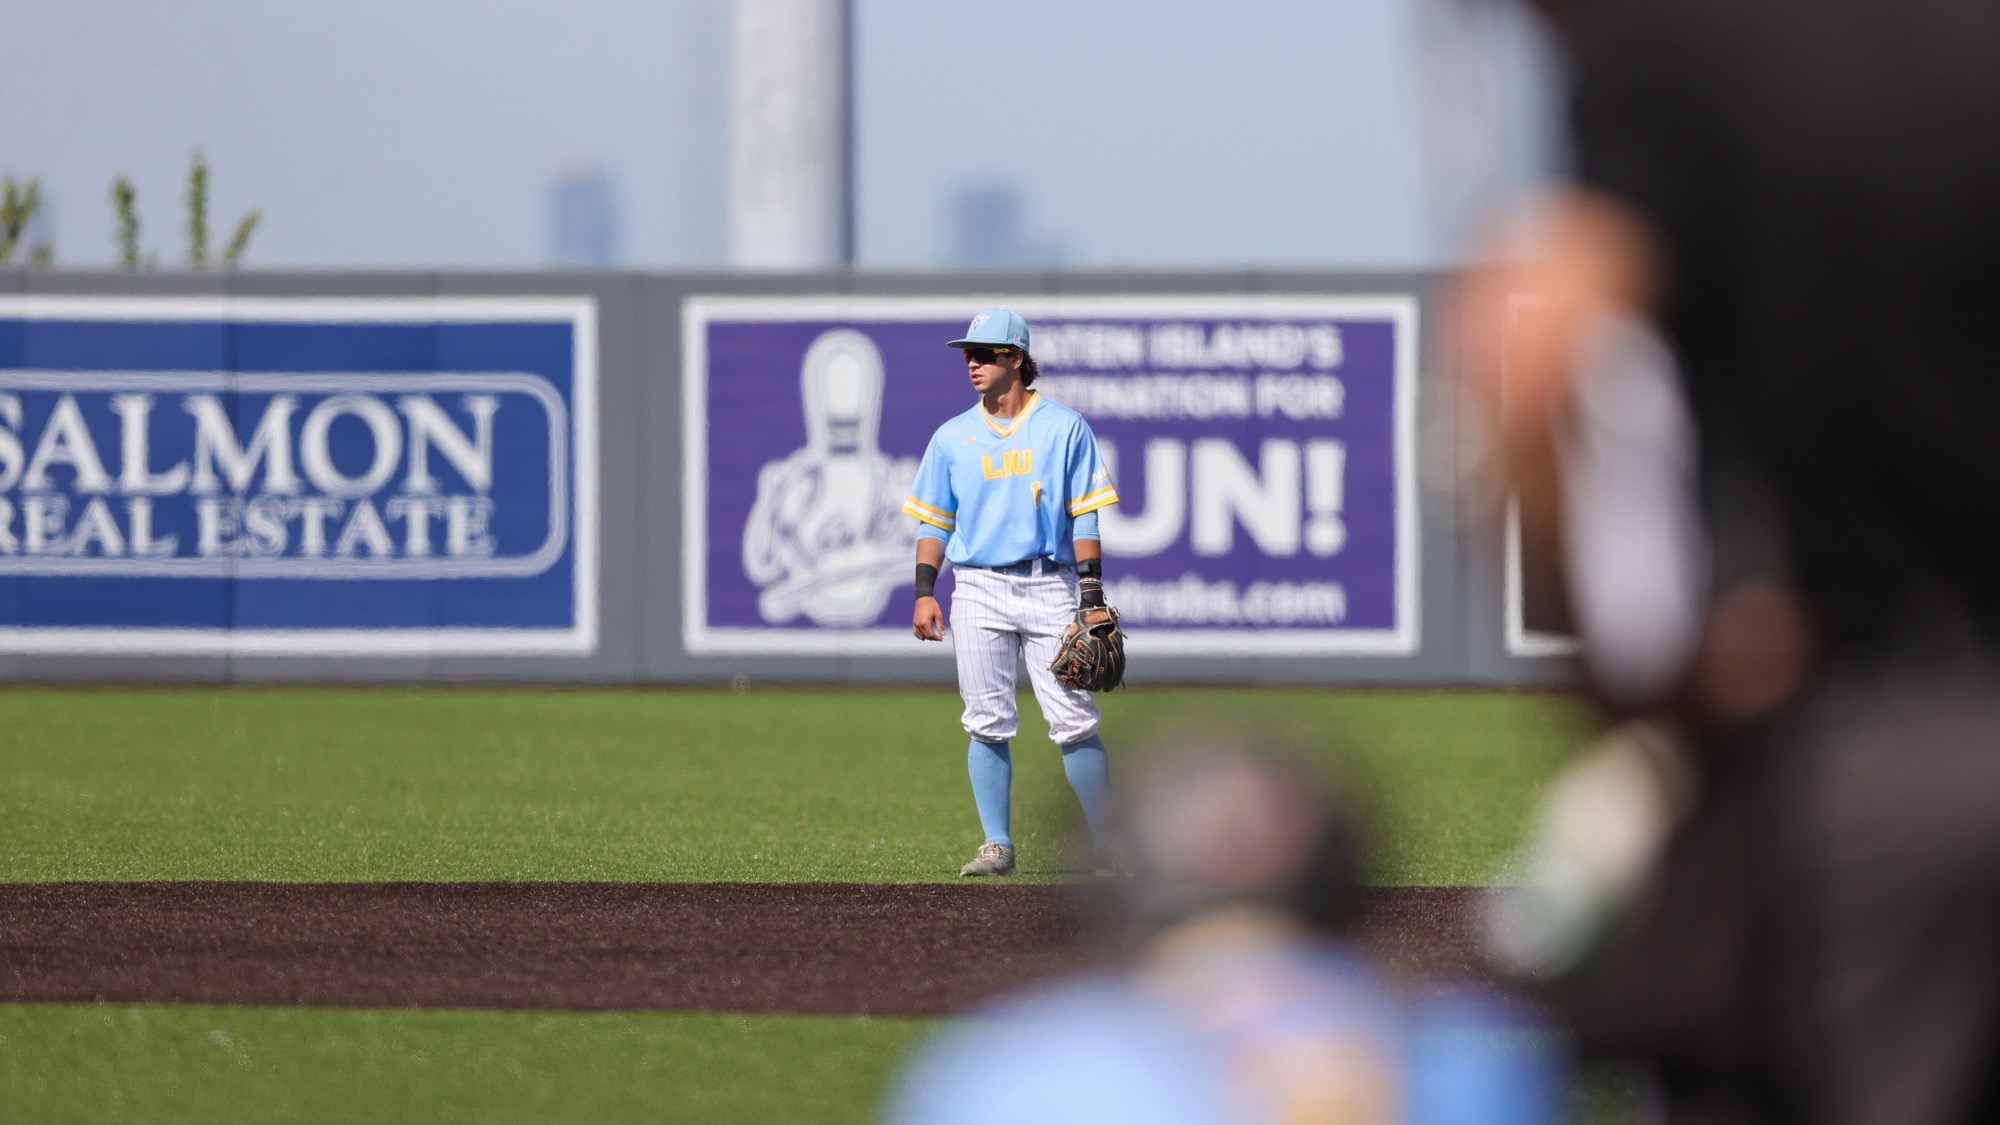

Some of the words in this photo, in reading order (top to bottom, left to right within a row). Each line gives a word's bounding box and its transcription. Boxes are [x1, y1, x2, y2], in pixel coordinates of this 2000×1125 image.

[1029, 325, 1141, 365] ATEN
[1150, 324, 1343, 367] ISLAND'S
[1029, 376, 1249, 417] TINATION
[1256, 375, 1344, 418] FOR
[982, 448, 1032, 480] LIU
[1031, 481, 1041, 509] 1
[1098, 438, 1346, 557] UN!
[197, 497, 496, 557] ESTATE
